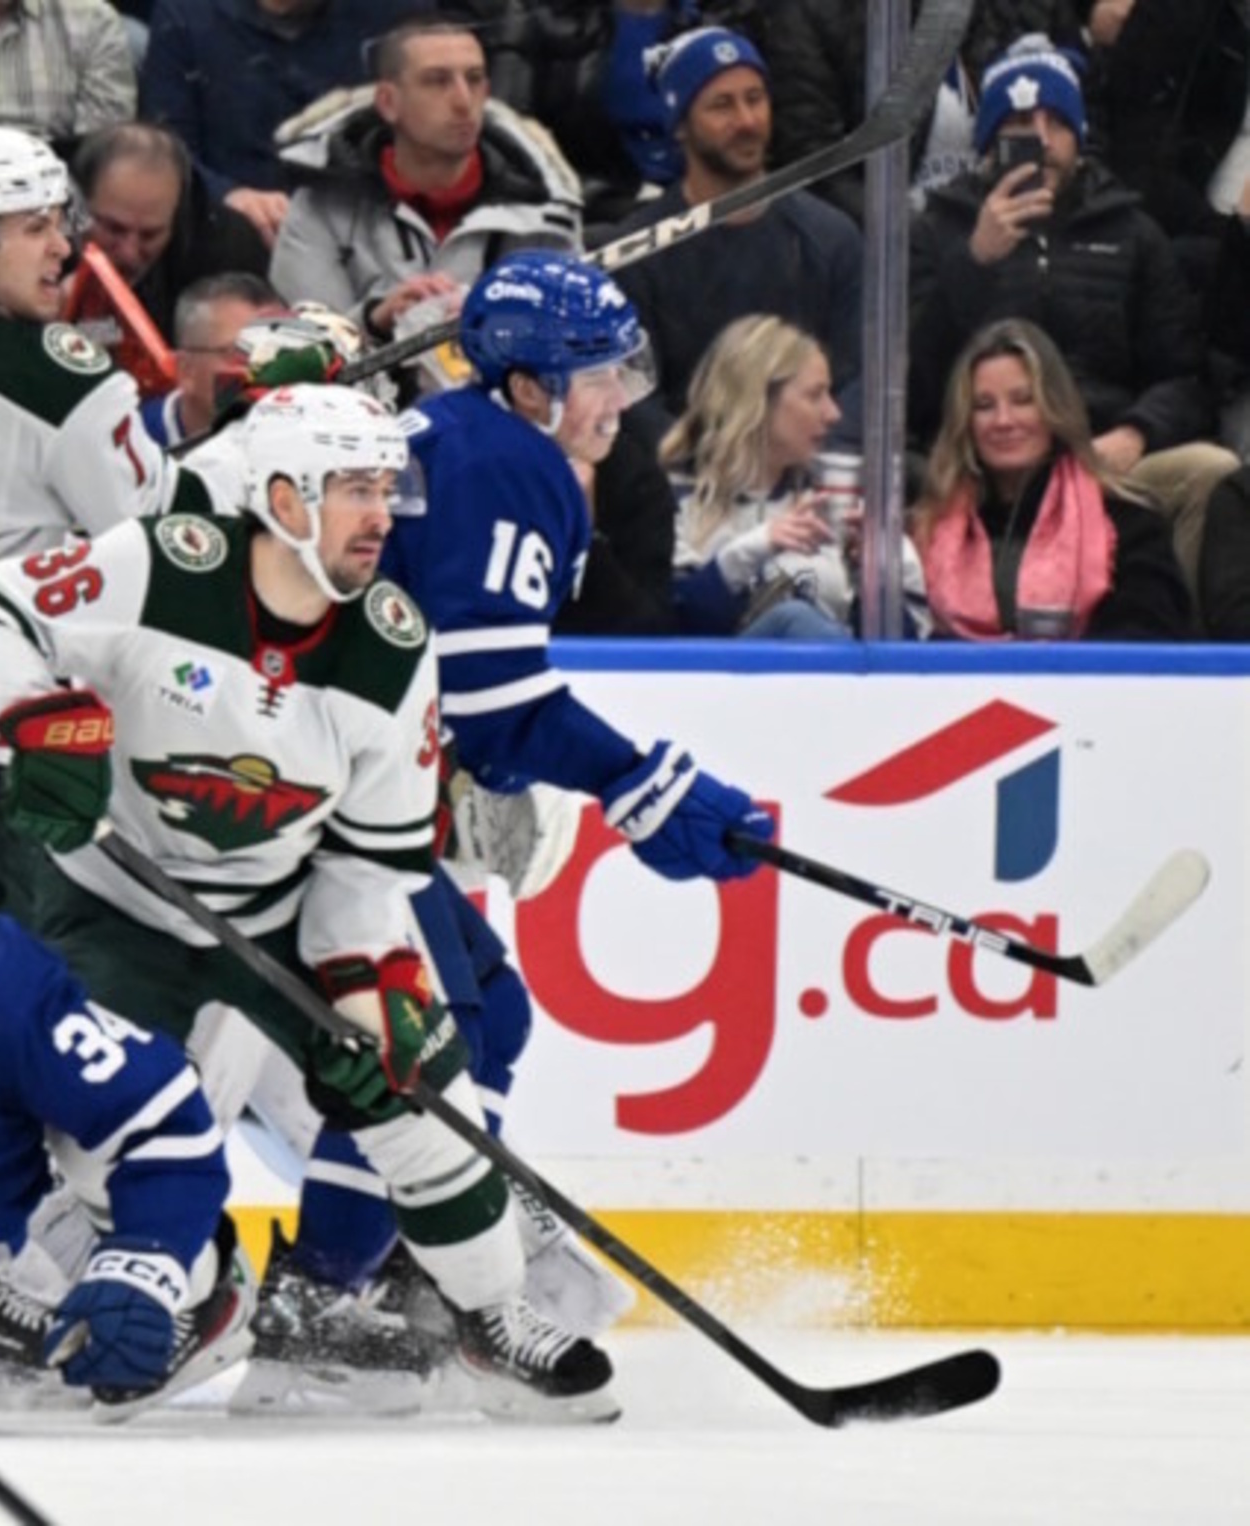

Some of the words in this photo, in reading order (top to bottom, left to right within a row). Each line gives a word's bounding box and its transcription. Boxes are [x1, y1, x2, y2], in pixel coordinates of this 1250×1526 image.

[581, 200, 712, 273] CM
[111, 411, 147, 491] 7
[21, 538, 105, 618] 36
[483, 518, 553, 611] 16
[53, 999, 153, 1083] 34
[90, 1254, 182, 1303] CCM
